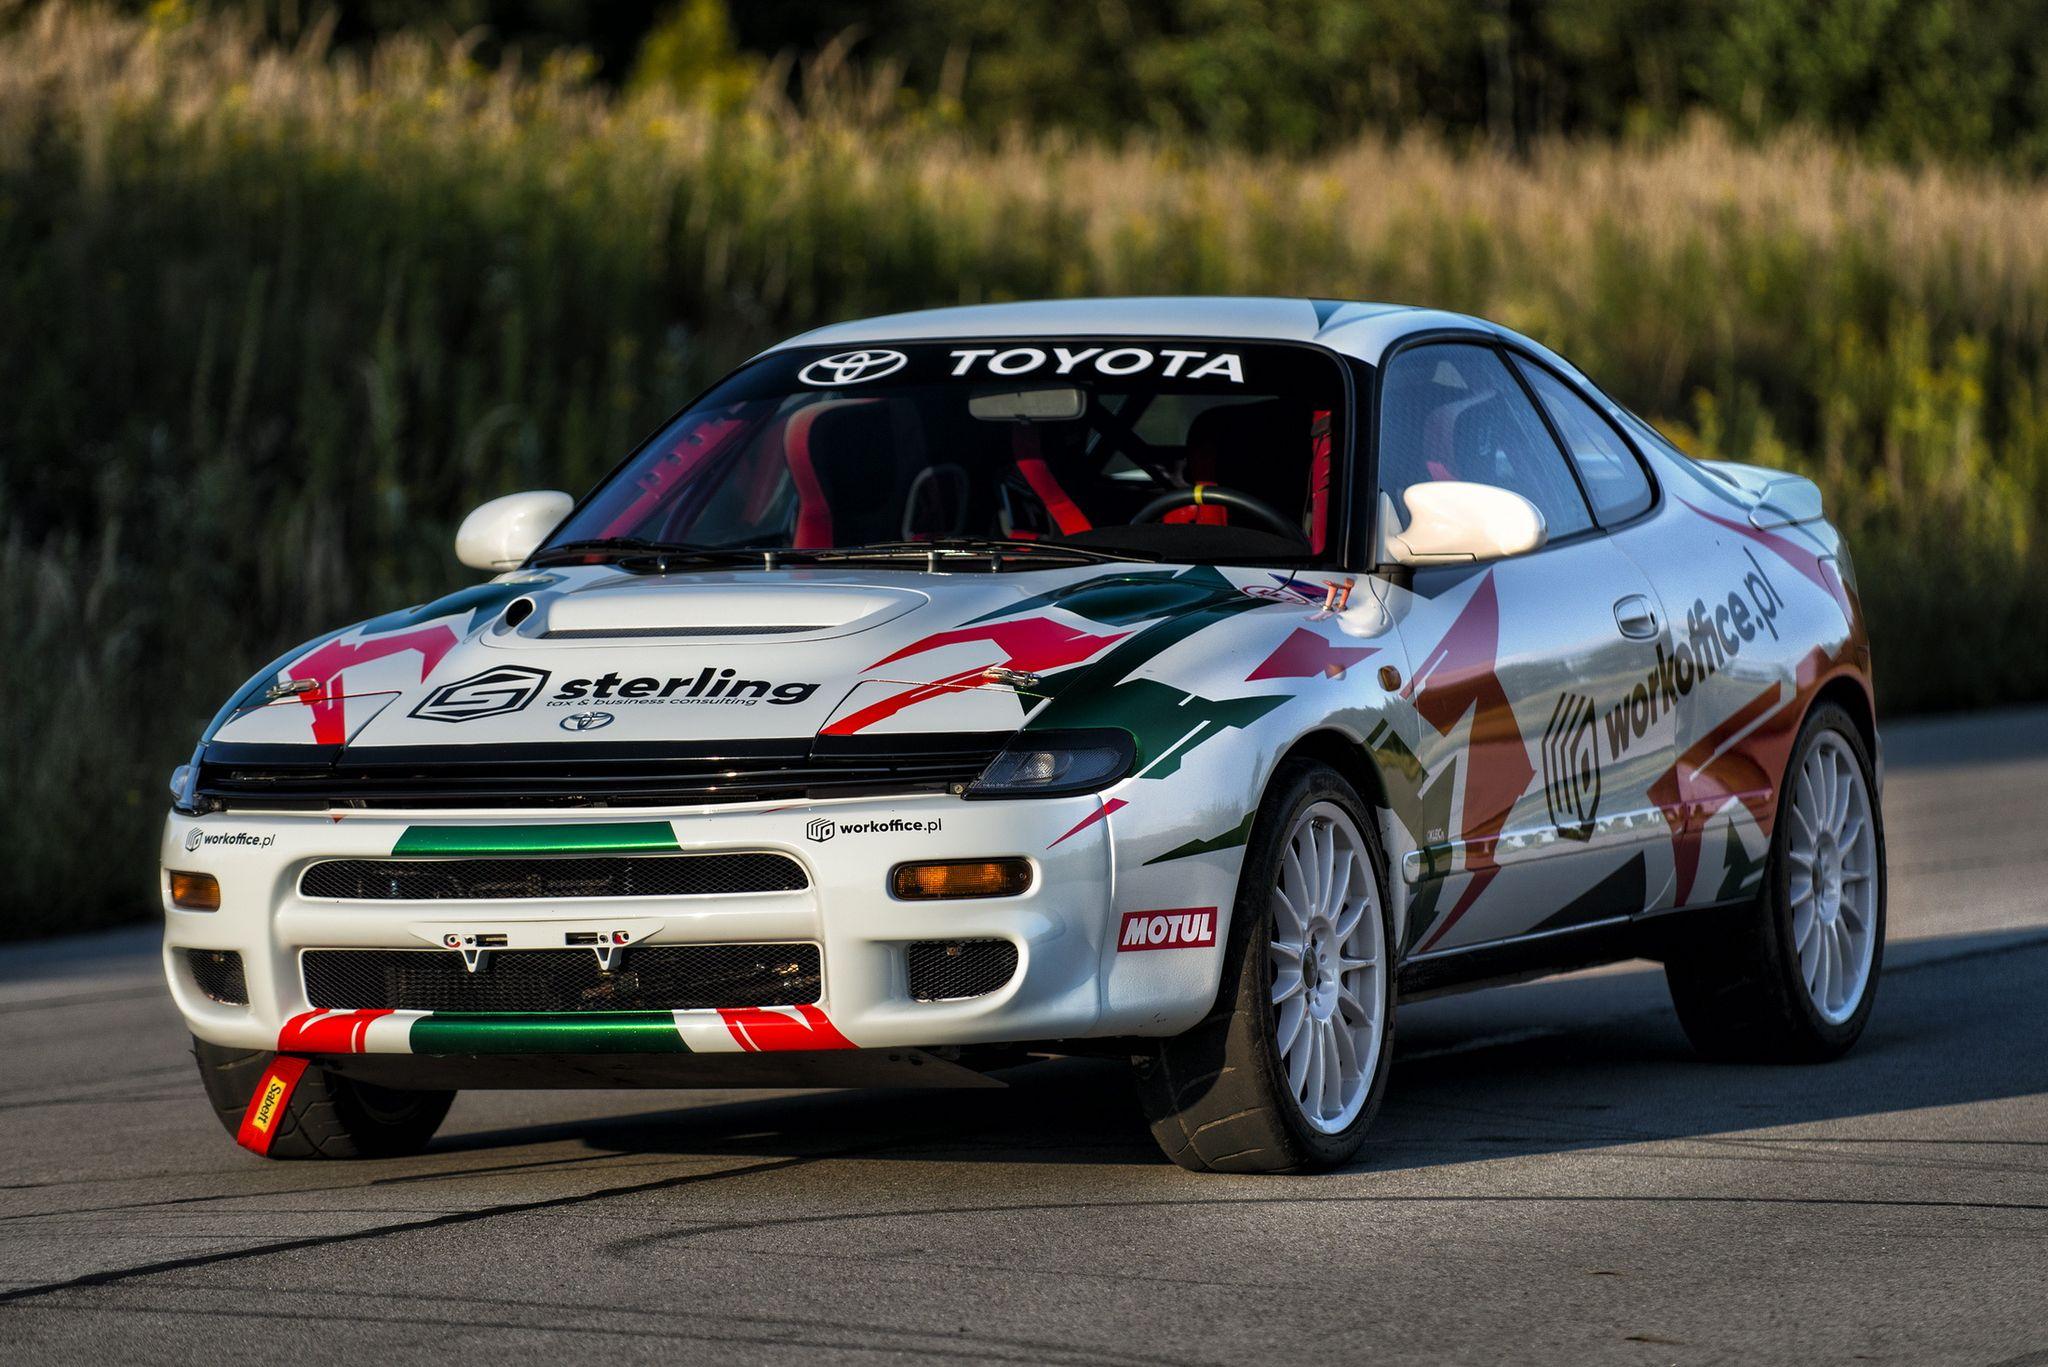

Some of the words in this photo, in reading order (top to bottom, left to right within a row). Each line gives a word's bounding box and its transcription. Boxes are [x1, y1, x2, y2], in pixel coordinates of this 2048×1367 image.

[949, 347, 1246, 384] TOYOTA
[1605, 546, 1785, 762] workoffice.pl
[553, 667, 822, 705] sterling
[670, 698, 758, 706] consulting
[204, 831, 276, 849] workoffice.pl
[840, 818, 942, 834] workoffice.pl
[1122, 912, 1213, 946] MOTUL
[257, 1083, 282, 1124] Sabelt
